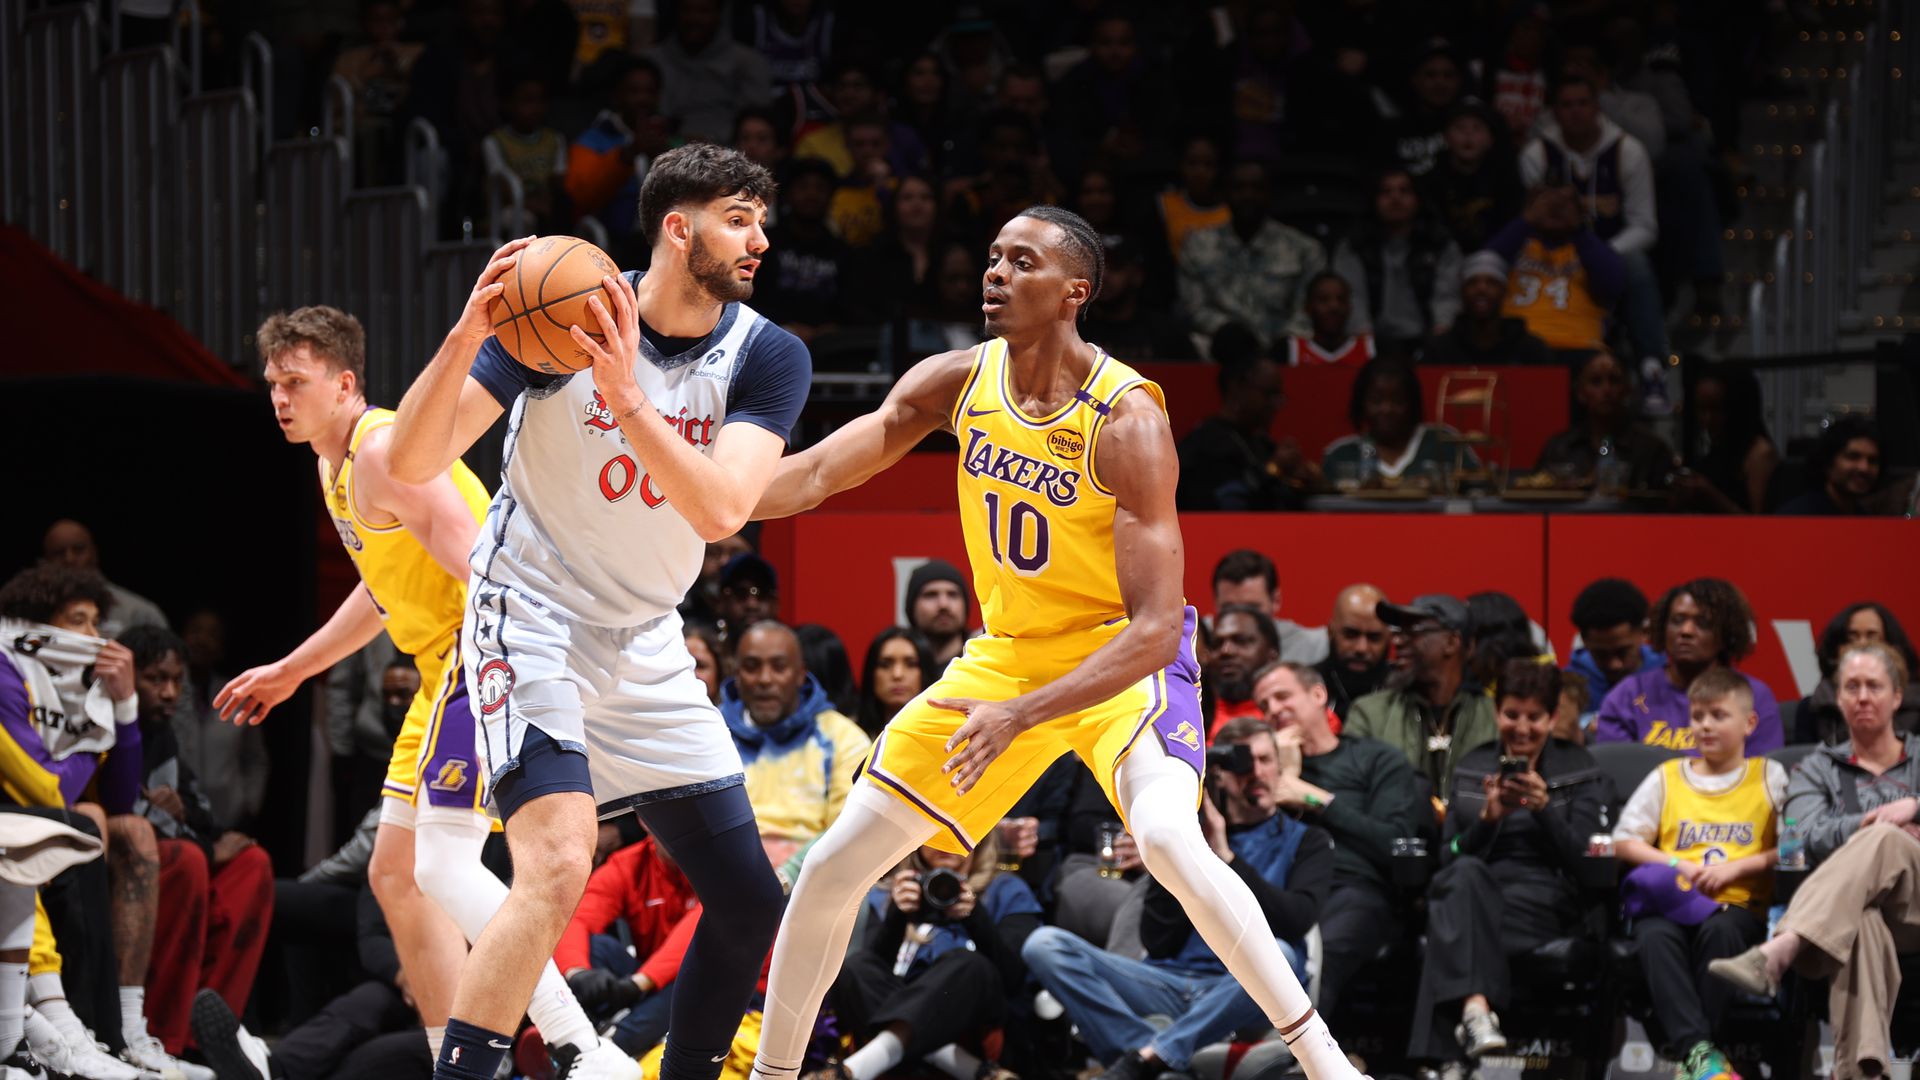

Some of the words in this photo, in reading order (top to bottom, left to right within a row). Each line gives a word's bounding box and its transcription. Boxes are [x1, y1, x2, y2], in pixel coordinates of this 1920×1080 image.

[963, 428, 1081, 507] LAKERS
[1051, 435, 1083, 453] bibigo
[984, 491, 1049, 577] 10
[1676, 820, 1754, 850] LAKERS
